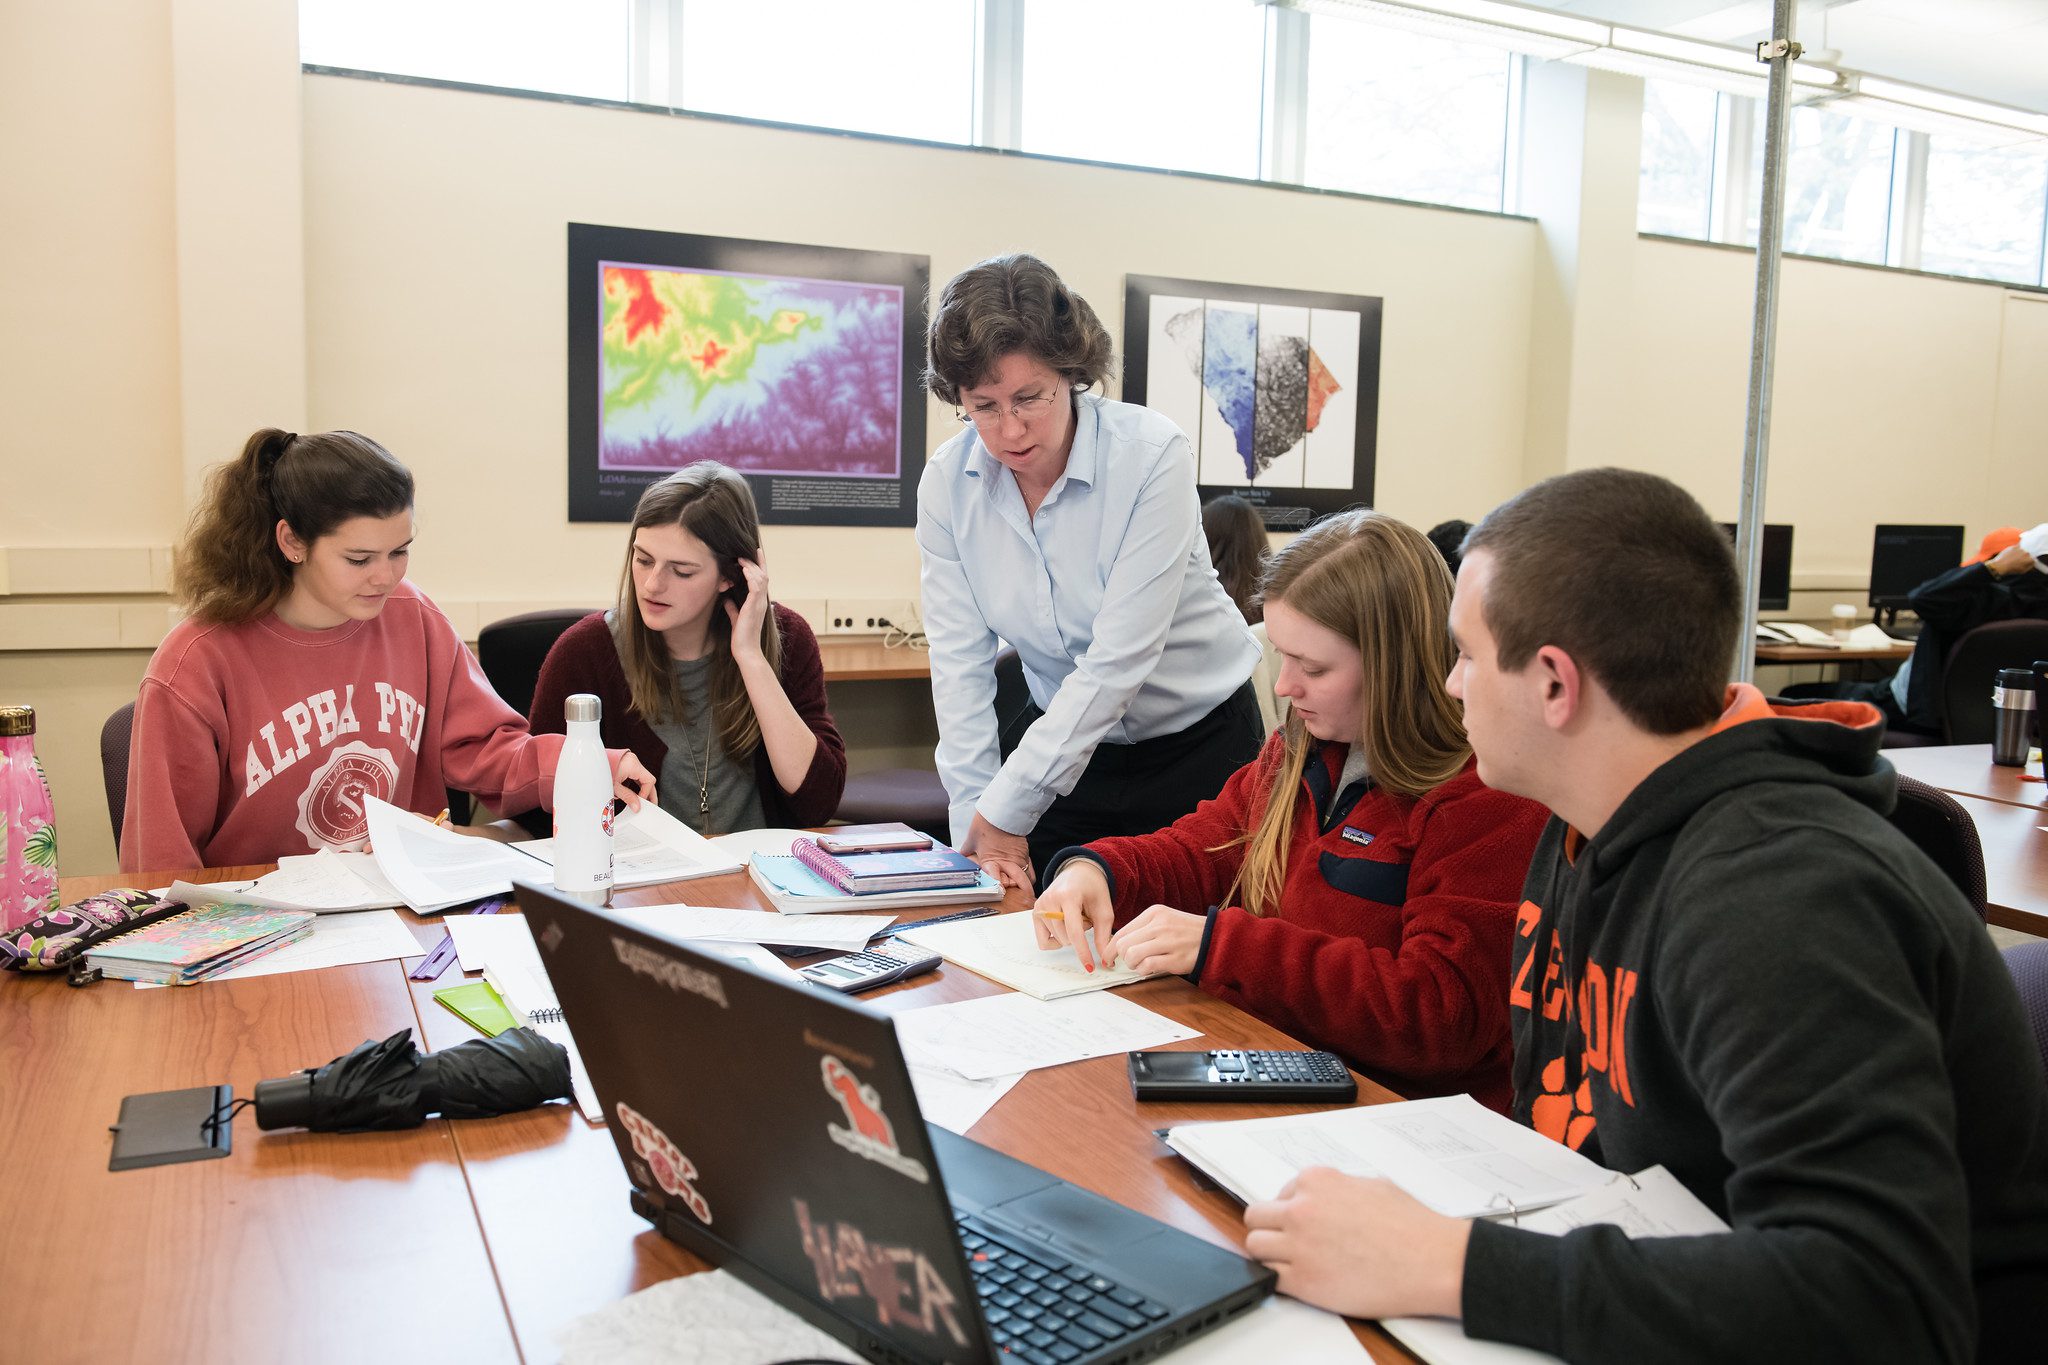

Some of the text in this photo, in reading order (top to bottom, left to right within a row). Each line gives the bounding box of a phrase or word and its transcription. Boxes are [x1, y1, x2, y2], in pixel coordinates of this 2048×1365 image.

[246, 682, 426, 798] ALPHA PHI
[322, 759, 384, 793] ALPHA PHI
[348, 822, 367, 837] 1872
[1342, 832, 1370, 845] patagonia
